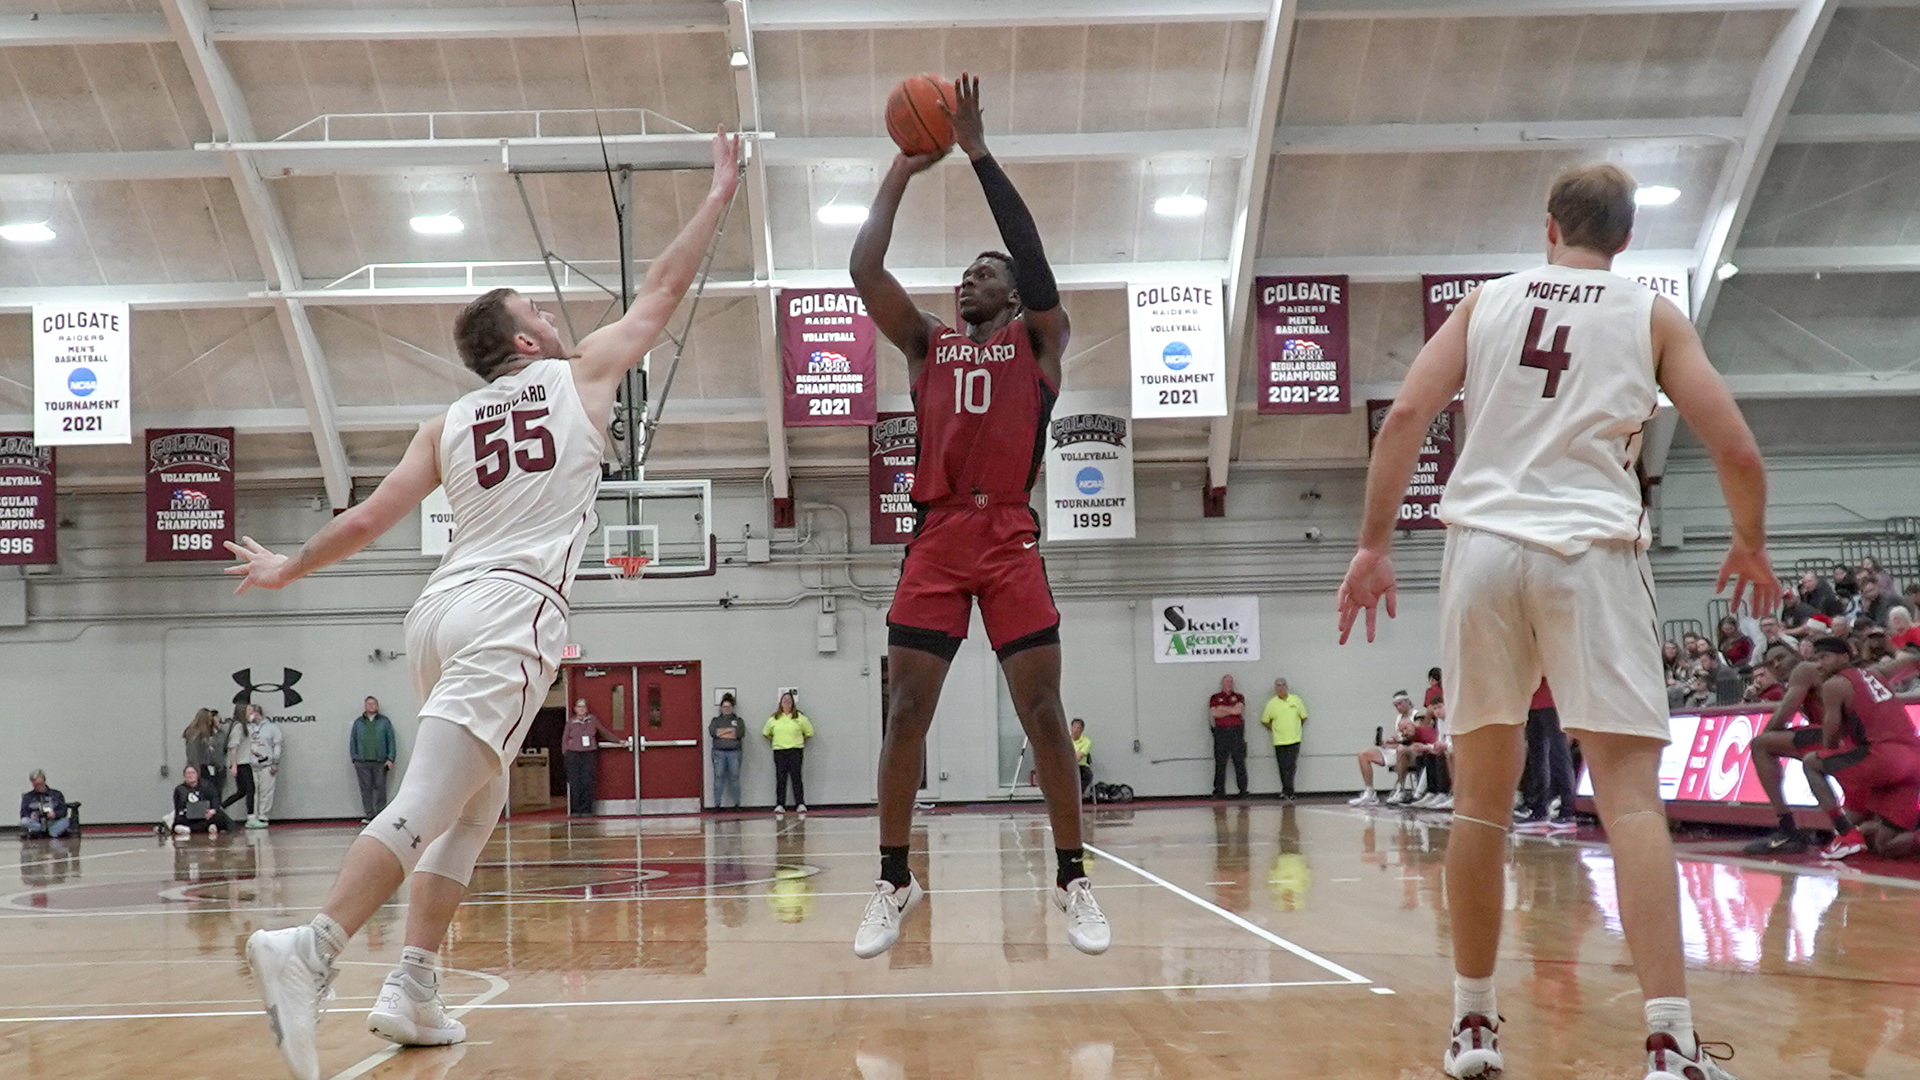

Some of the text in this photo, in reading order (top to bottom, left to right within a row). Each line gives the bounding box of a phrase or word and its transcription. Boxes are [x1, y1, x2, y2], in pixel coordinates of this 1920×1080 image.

[1430, 279, 1484, 303] COLG
[1525, 281, 1606, 304] MOFFATT
[1637, 276, 1679, 297] GATE
[1137, 286, 1213, 307] COLGATE
[1264, 282, 1341, 305] COLGATE
[789, 293, 868, 317] COLGATE
[1279, 305, 1326, 314] RAIDERS
[1152, 308, 1198, 316] RAIDERS
[43, 311, 119, 334] COLGATE
[804, 317, 853, 325] RAIDERS
[1288, 316, 1317, 325] MEN'S
[1150, 324, 1202, 333] VOLLEYBALL
[1275, 325, 1331, 335] BASKETBALL
[802, 332, 856, 342] VOLLEYBALL
[67, 345, 95, 353] MEN'S
[936, 343, 1016, 365] HARVARD
[1519, 306, 1572, 399] 4
[54, 354, 108, 363] BASKETBALL
[1271, 361, 1337, 371] REGULAR SEASON
[1140, 373, 1215, 385] TOURNAMENT
[1271, 370, 1337, 382] CHAMPIONS
[796, 382, 864, 394] CHAMPIONS
[953, 367, 993, 415] 10
[1269, 385, 1340, 403] 2021-22
[1159, 389, 1199, 405] 2021
[44, 400, 120, 411] TOURNAMENT
[809, 398, 851, 416] 2021
[62, 416, 103, 432] 2021
[875, 418, 917, 440] COLG
[1052, 414, 1127, 436] COLGATE
[472, 407, 557, 490] 55
[883, 456, 916, 466] VOLLE
[1060, 451, 1119, 461] VOLLEYBALL
[0, 475, 42, 486] LEYBALL
[160, 472, 221, 482] VOLLEYBALL
[1412, 475, 1435, 484] SON
[1406, 485, 1447, 496] MPIONS
[0, 496, 38, 507] GULAR
[1055, 498, 1127, 509] TOURNAMENT
[0, 508, 35, 518] EASON
[157, 510, 225, 519] TOURNAMENT
[1401, 503, 1441, 520] 03-0
[0, 519, 45, 530] MPIONS
[157, 519, 225, 531] CHAMPIONS
[895, 517, 917, 534] 19
[1073, 513, 1112, 528] 1999
[0, 538, 34, 554] 996
[172, 533, 213, 550] 1996
[1163, 605, 1239, 632] Skeele
[1165, 634, 1239, 656] Agency
[1192, 647, 1249, 656] INSURANCE
